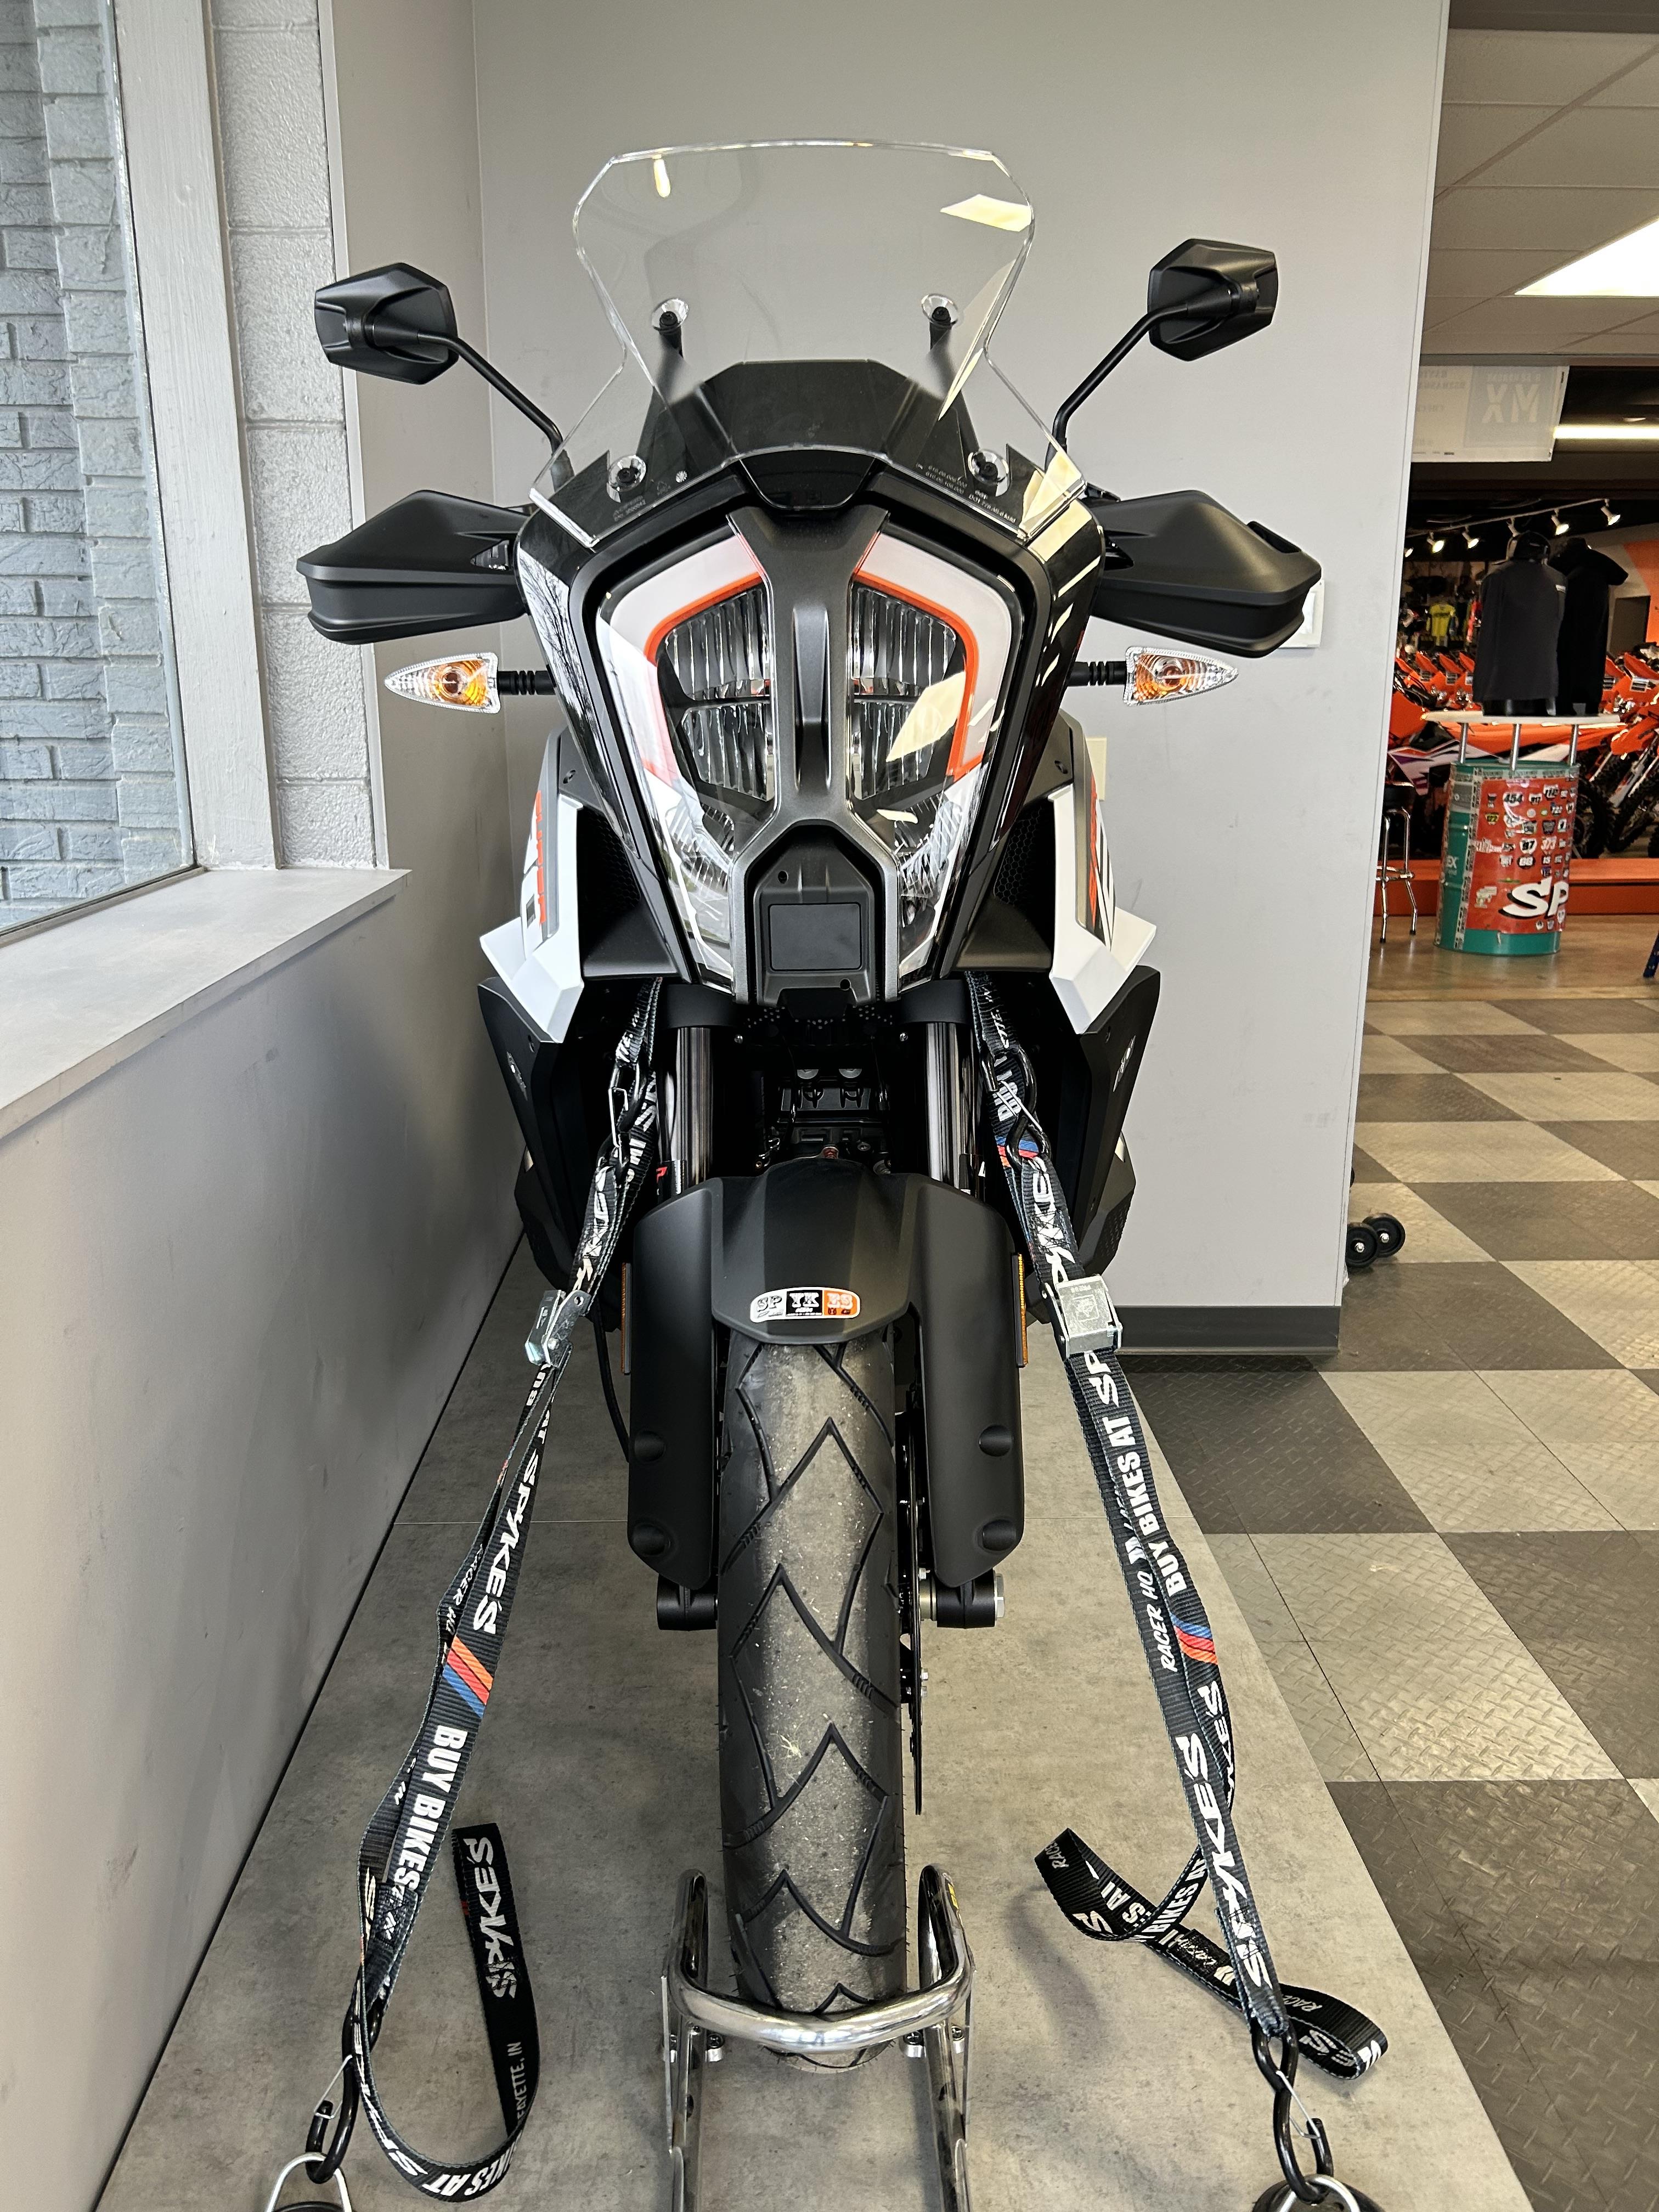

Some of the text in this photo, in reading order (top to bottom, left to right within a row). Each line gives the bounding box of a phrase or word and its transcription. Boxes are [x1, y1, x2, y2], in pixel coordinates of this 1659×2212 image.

[1102, 1415, 1137, 1447] AT
[1117, 1451, 1161, 1536] BIKES
[1148, 1540, 1187, 1598] BUY
[1137, 1570, 1178, 1673] RACER HQ
[421, 1725, 468, 1793] BUY
[393, 1793, 445, 1892] BIKES
[1146, 1881, 1199, 1936] BIKES
[506, 2041, 523, 2057] IN
[421, 2174, 472, 2197] AT
